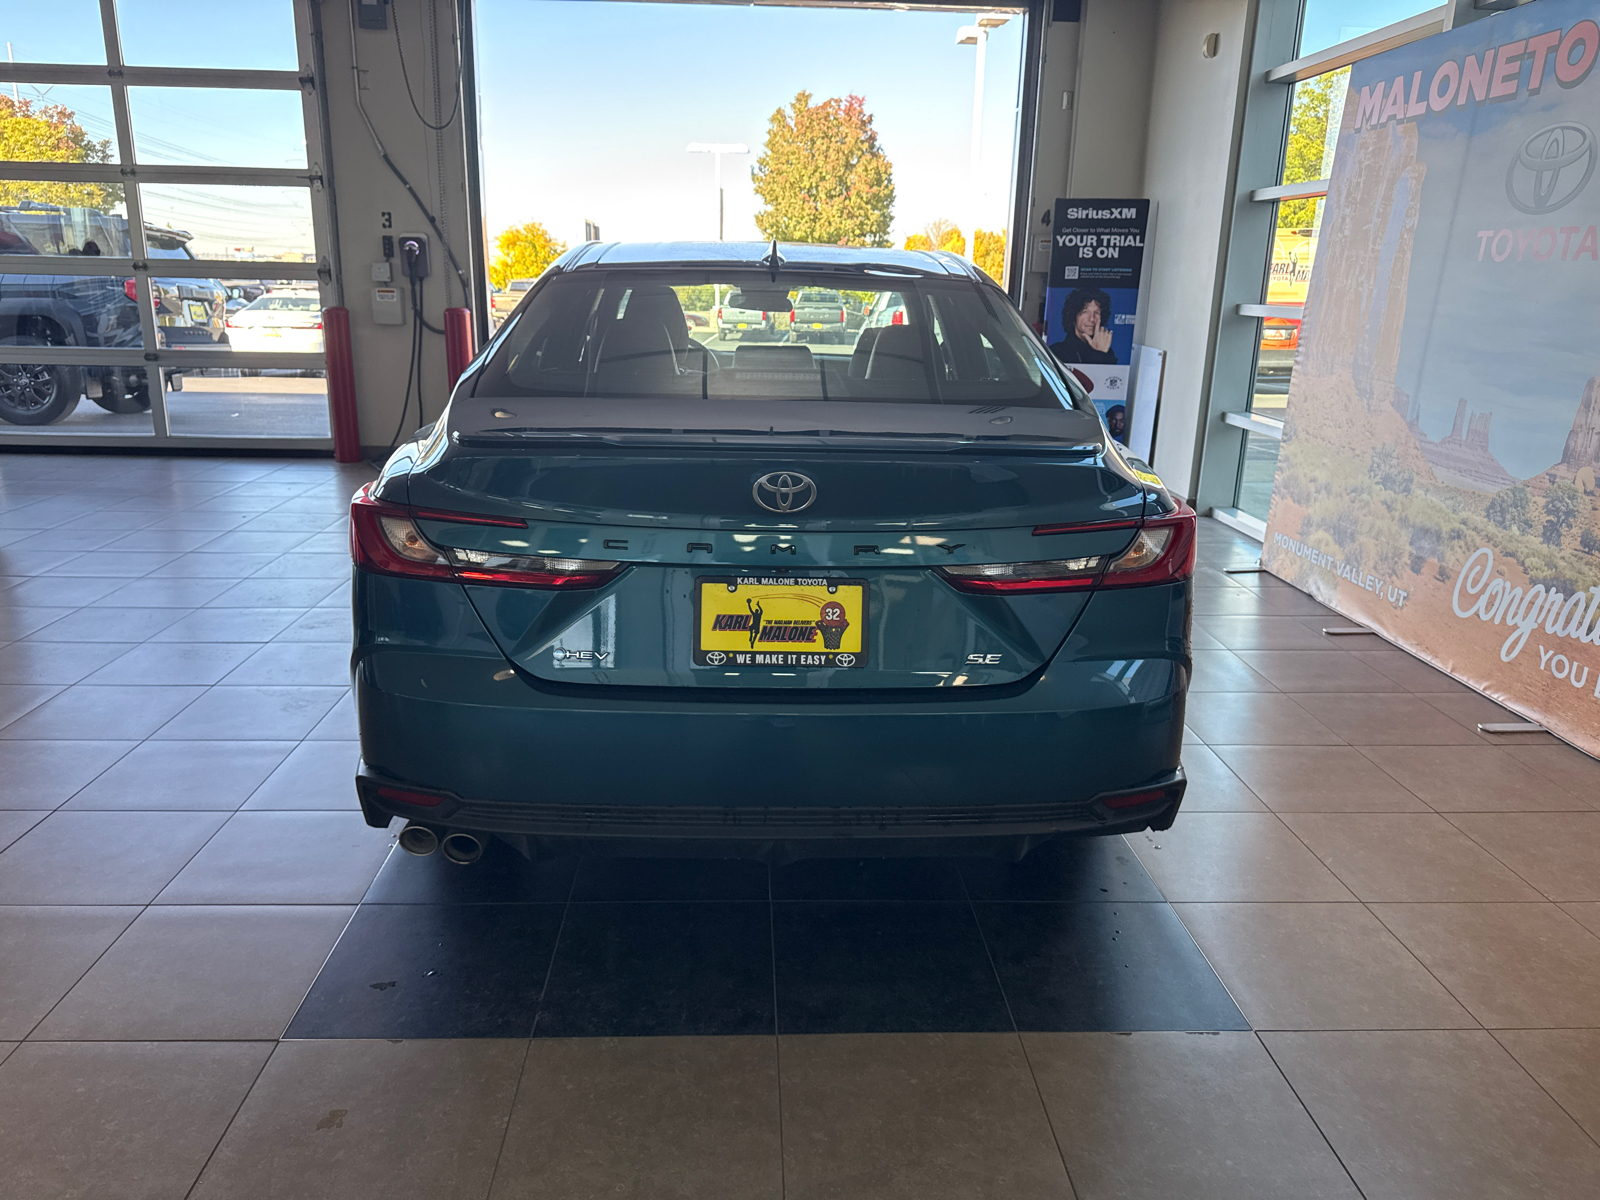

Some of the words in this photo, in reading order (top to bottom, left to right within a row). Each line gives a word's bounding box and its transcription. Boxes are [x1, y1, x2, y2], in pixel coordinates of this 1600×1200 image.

[381, 211, 393, 229] 3
[1067, 207, 1137, 219] SiriusXM
[1056, 235, 1098, 247] YOUR
[1100, 235, 1144, 247] TRIAL
[1476, 225, 1599, 263] TOYOTA
[1078, 247, 1093, 259] IS
[1096, 247, 1119, 259] ON
[602, 539, 967, 555] CAMRY
[1273, 531, 1334, 571] MONUMENT
[1336, 560, 1384, 600] VALLEY,
[1387, 584, 1408, 606] UT
[737, 577, 760, 585] KARL
[761, 577, 795, 586] MALONE
[797, 578, 828, 586] TOYOTA
[825, 607, 840, 621] 32
[711, 614, 753, 631] KARL
[758, 625, 818, 642] MALONE
[566, 650, 609, 660] HEV
[736, 654, 752, 664] WE
[755, 654, 784, 665] MAKE
[787, 654, 797, 665] IT
[800, 654, 826, 665] EASY
[964, 653, 1003, 665] SE
[1539, 644, 1589, 688] YOU
